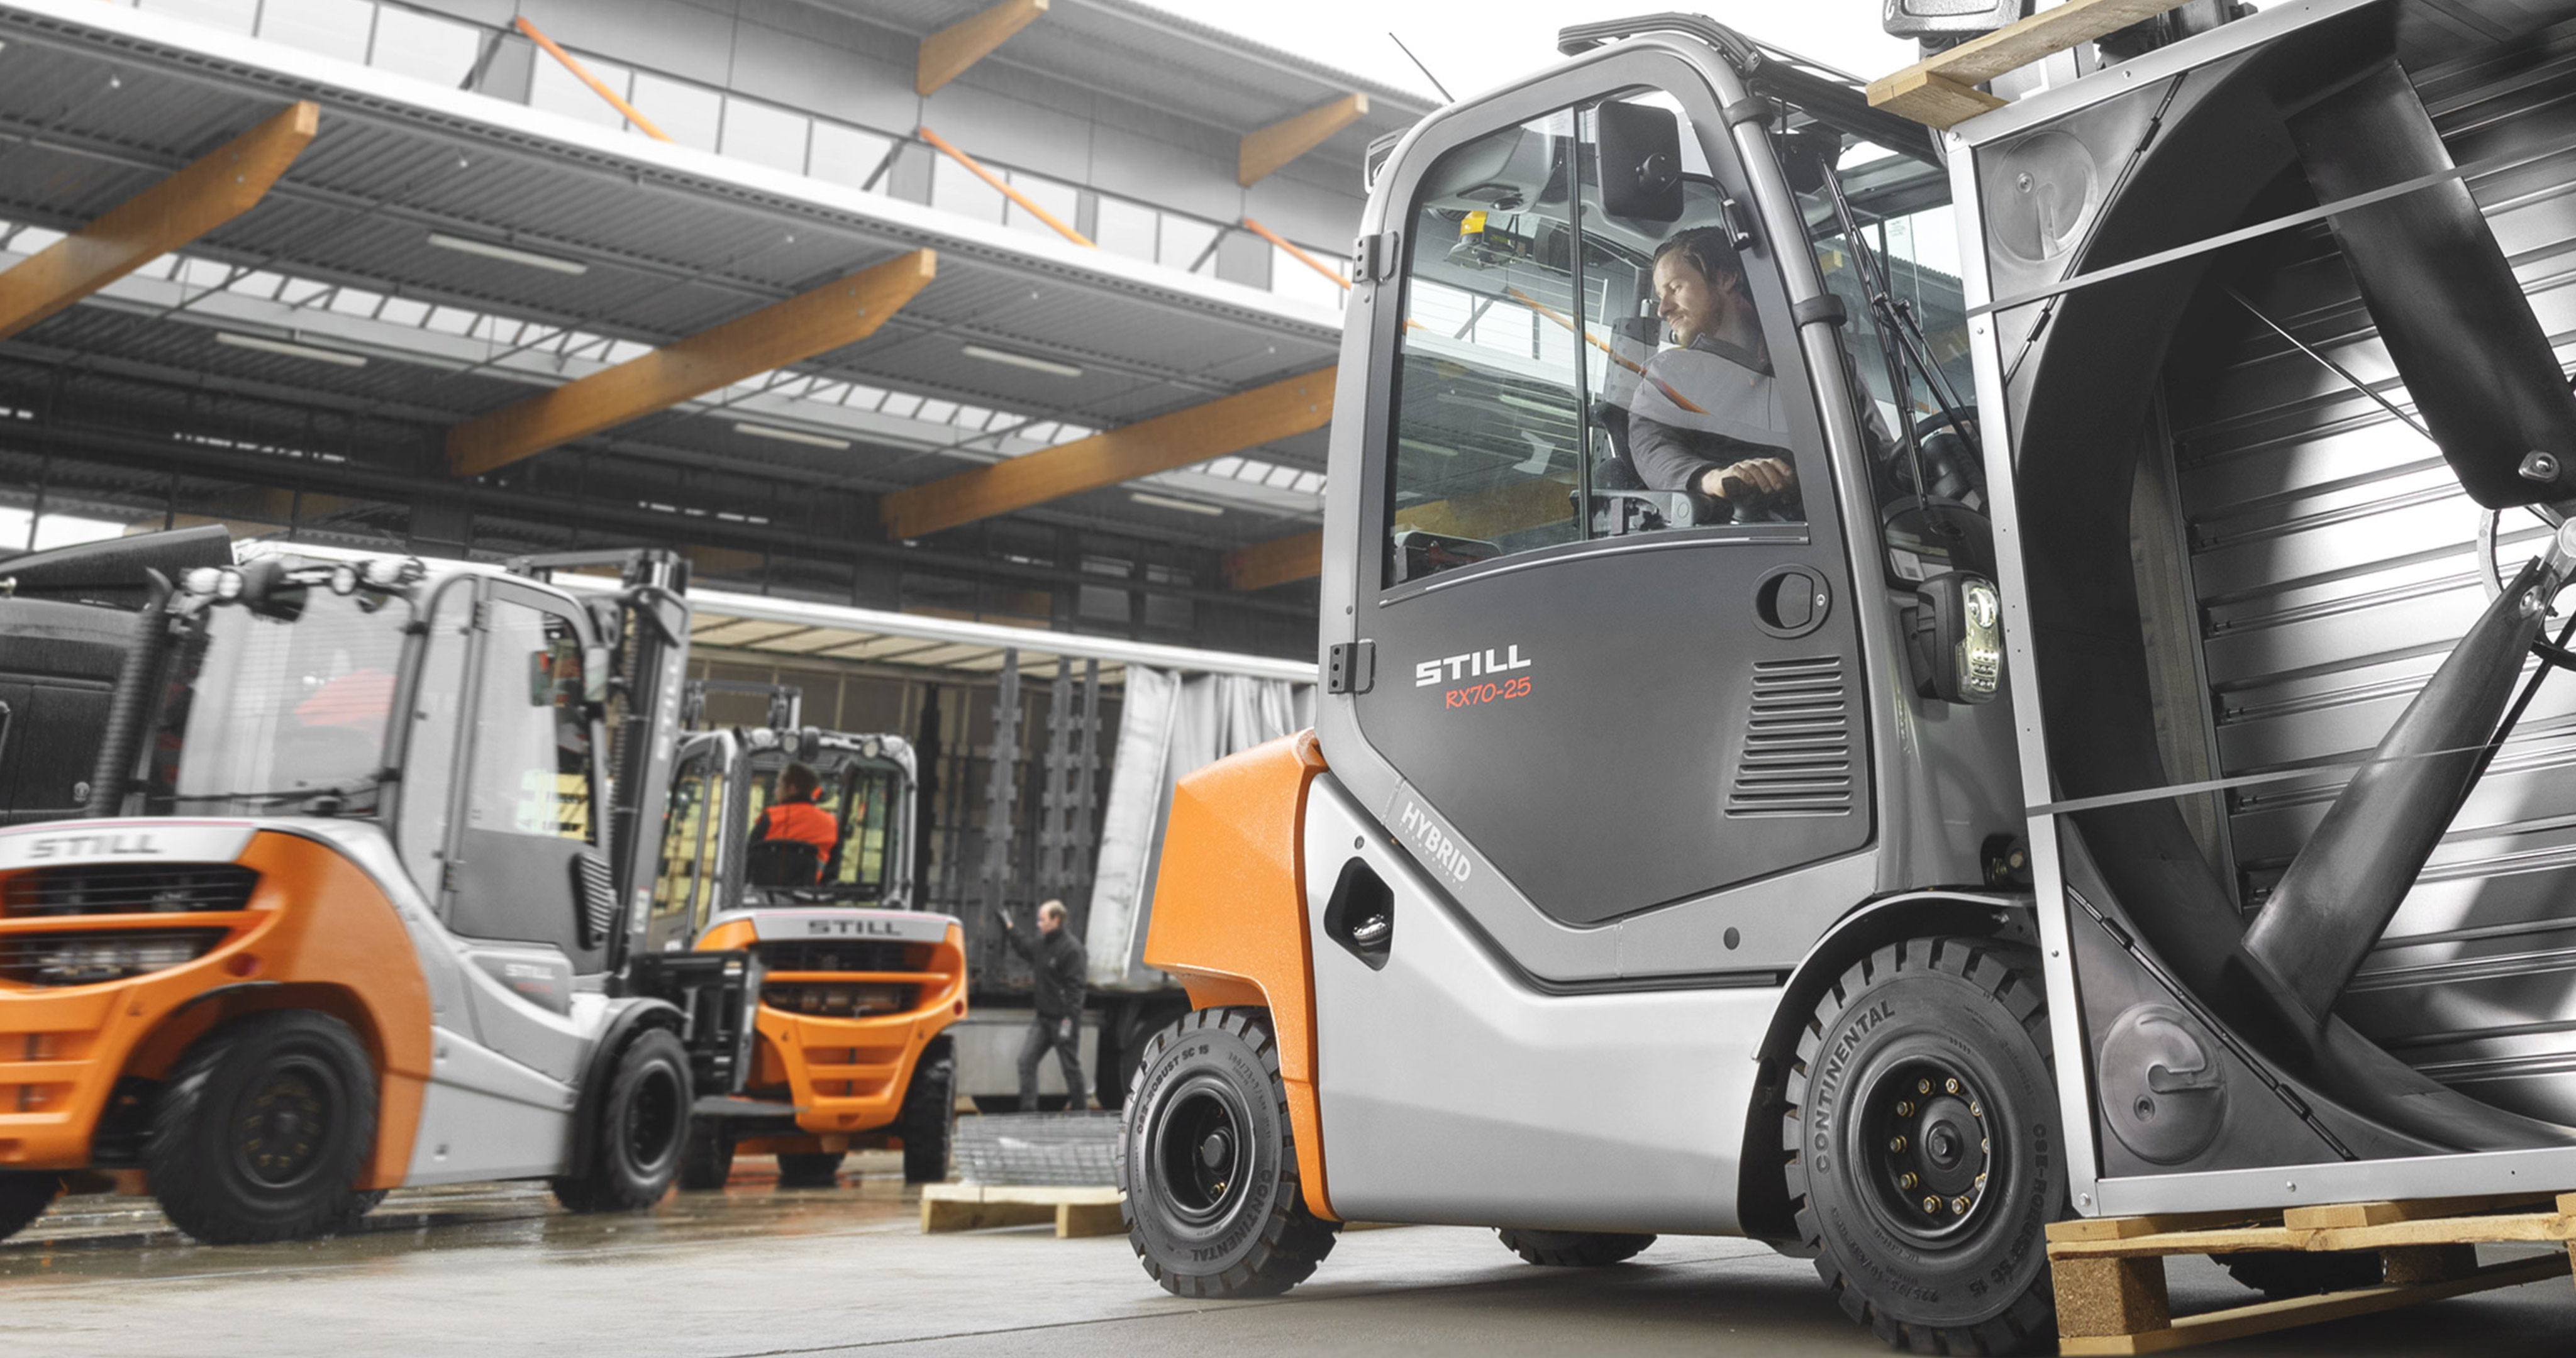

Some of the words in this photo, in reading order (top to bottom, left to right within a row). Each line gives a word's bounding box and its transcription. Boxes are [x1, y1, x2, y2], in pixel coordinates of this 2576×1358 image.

[1416, 644, 1531, 687] STILL
[1446, 676, 1531, 709] RX70-25
[28, 835, 161, 858] STILL
[1401, 801, 1472, 881] HYBRID
[808, 920, 902, 936] STILL
[1182, 1047, 1195, 1060] SC
[1199, 1044, 1209, 1055] 15
[1814, 1000, 1896, 1174] CONTINENTAL
[1191, 1169, 1272, 1262] CONTINENTAL
